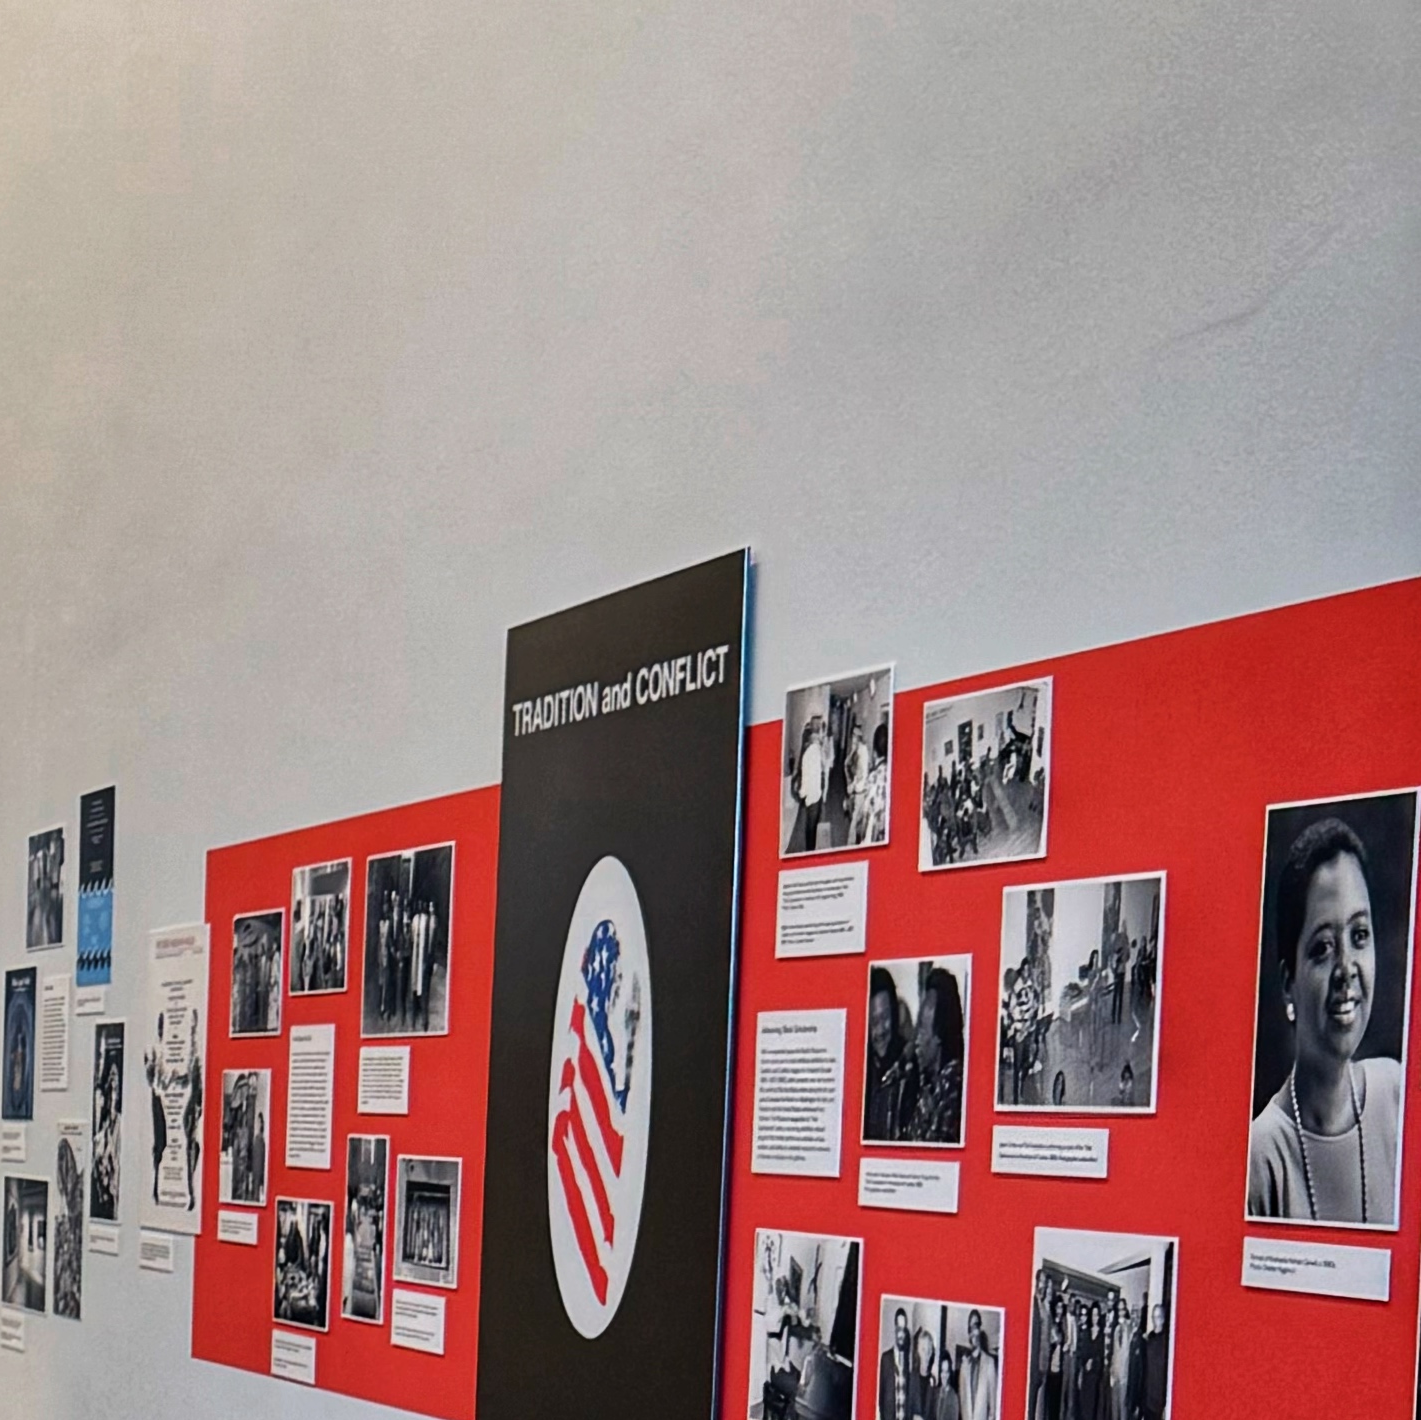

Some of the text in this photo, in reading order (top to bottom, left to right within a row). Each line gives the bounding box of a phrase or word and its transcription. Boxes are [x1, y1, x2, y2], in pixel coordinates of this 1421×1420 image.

[512, 644, 730, 737] TRADITION and CONFLICT
